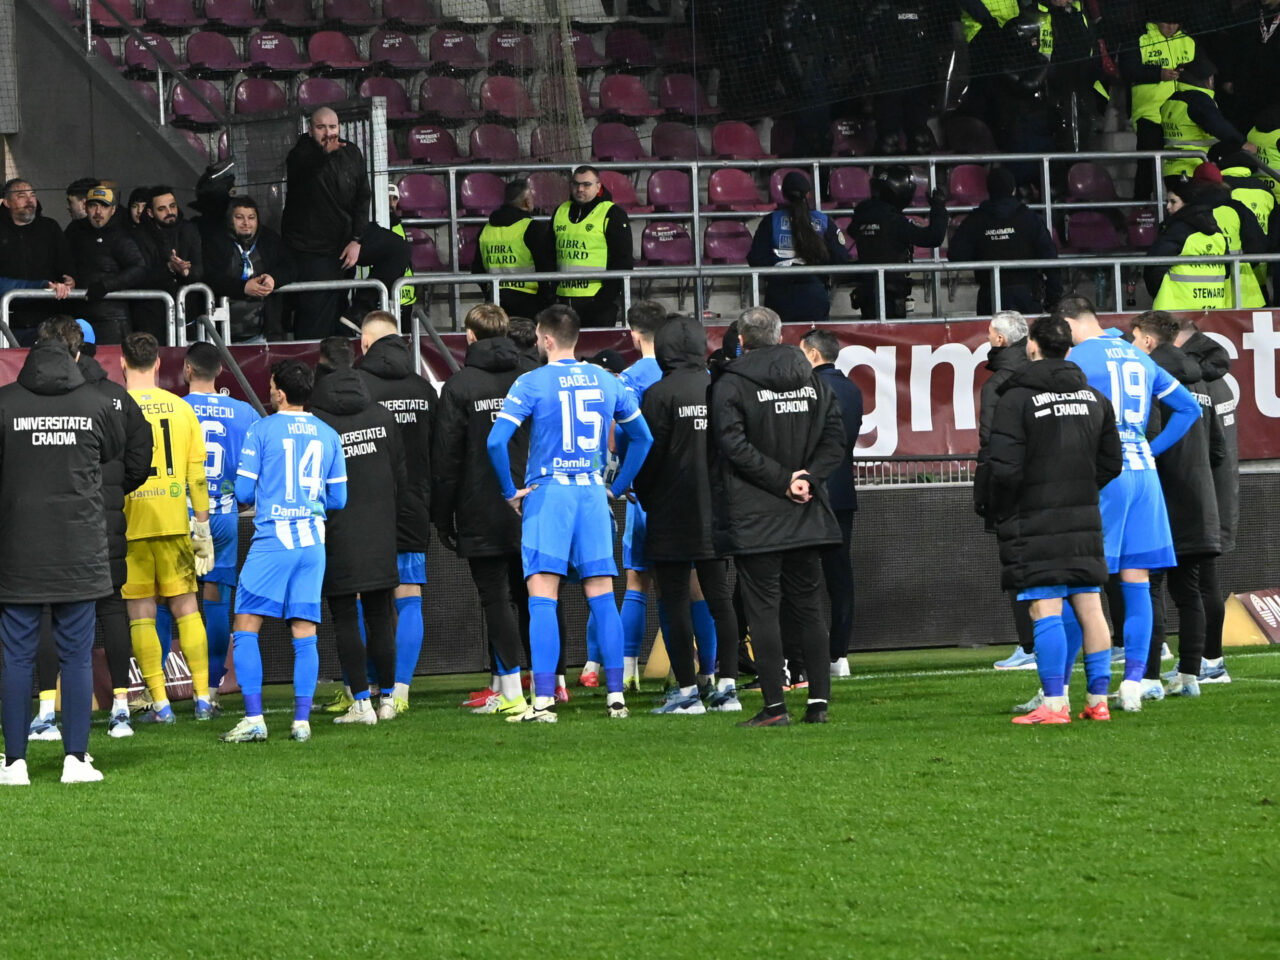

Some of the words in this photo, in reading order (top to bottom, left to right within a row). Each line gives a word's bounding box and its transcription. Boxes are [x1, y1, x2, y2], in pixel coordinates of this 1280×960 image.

[1192, 287, 1225, 300] STEWARD
[559, 374, 599, 388] BADELJ
[1106, 360, 1150, 426] 19
[139, 402, 174, 416] PESCU
[193, 404, 234, 419] SCRECIU
[774, 400, 809, 414] CRAIOVA
[1053, 403, 1090, 417] CRAIOVA
[13, 417, 93, 431] UNIVERSITATEA
[558, 389, 605, 453] 15
[287, 423, 317, 437] HOURI
[339, 427, 387, 446] VERSITATEA
[32, 431, 77, 445] CRAIOVA
[202, 420, 227, 481] 6
[342, 441, 377, 459] CRAIOVA
[552, 457, 591, 469] Damila
[282, 438, 325, 503] 14
[271, 504, 311, 518] Damila
